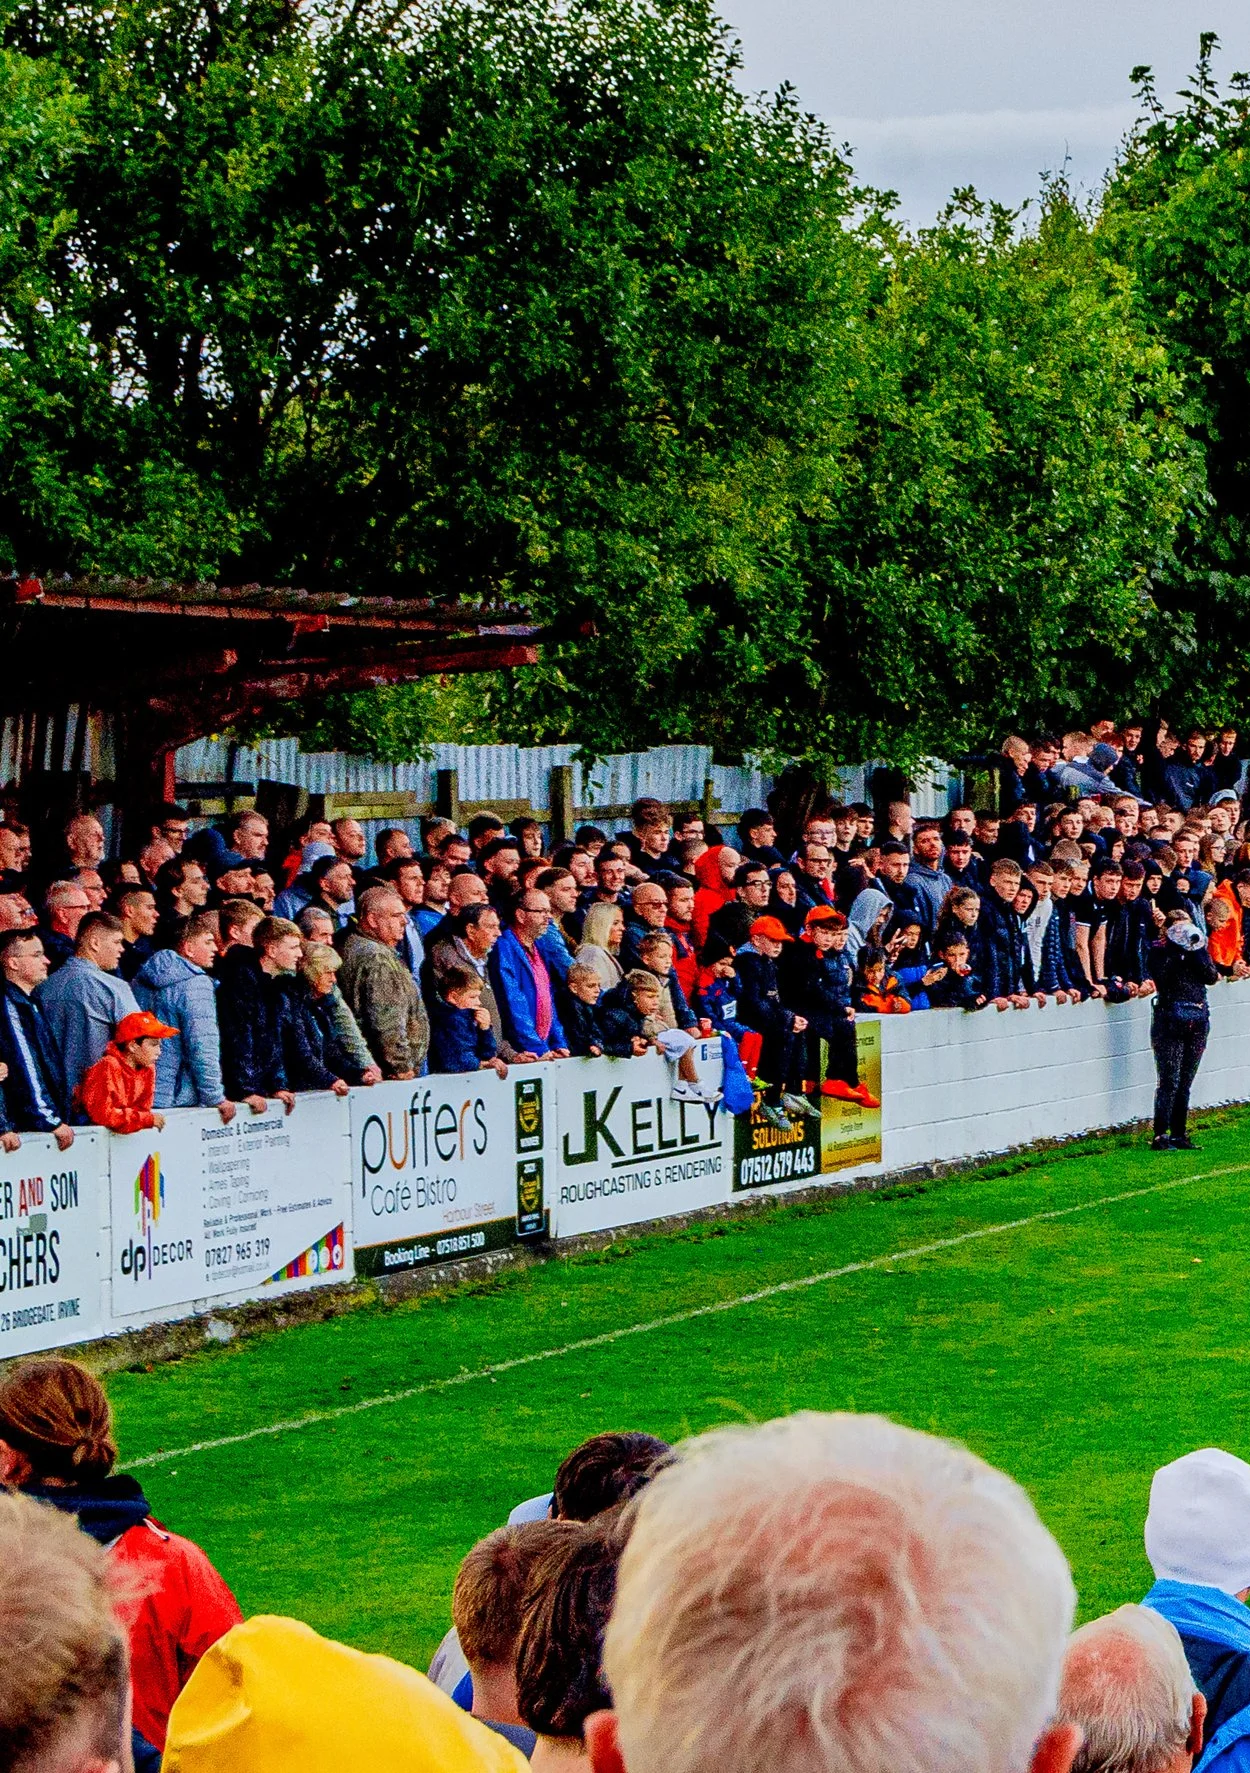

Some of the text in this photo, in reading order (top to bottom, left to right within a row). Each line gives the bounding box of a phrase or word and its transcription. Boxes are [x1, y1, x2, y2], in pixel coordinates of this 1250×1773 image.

[361, 1089, 488, 1198] puffers
[560, 1156, 722, 1204] ROUGHCASTING & RENDERING
[741, 1154, 773, 1185] 07512
[773, 1150, 793, 1179] 679
[794, 1146, 815, 1174] 443
[18, 1176, 44, 1218] AND
[50, 1170, 79, 1212] SON
[371, 1175, 457, 1216] Café Bistro
[153, 1239, 193, 1266] DECOR
[205, 1237, 271, 1268] 07827 965 319
[384, 1247, 414, 1266] Booking
[414, 1245, 430, 1260] Line
